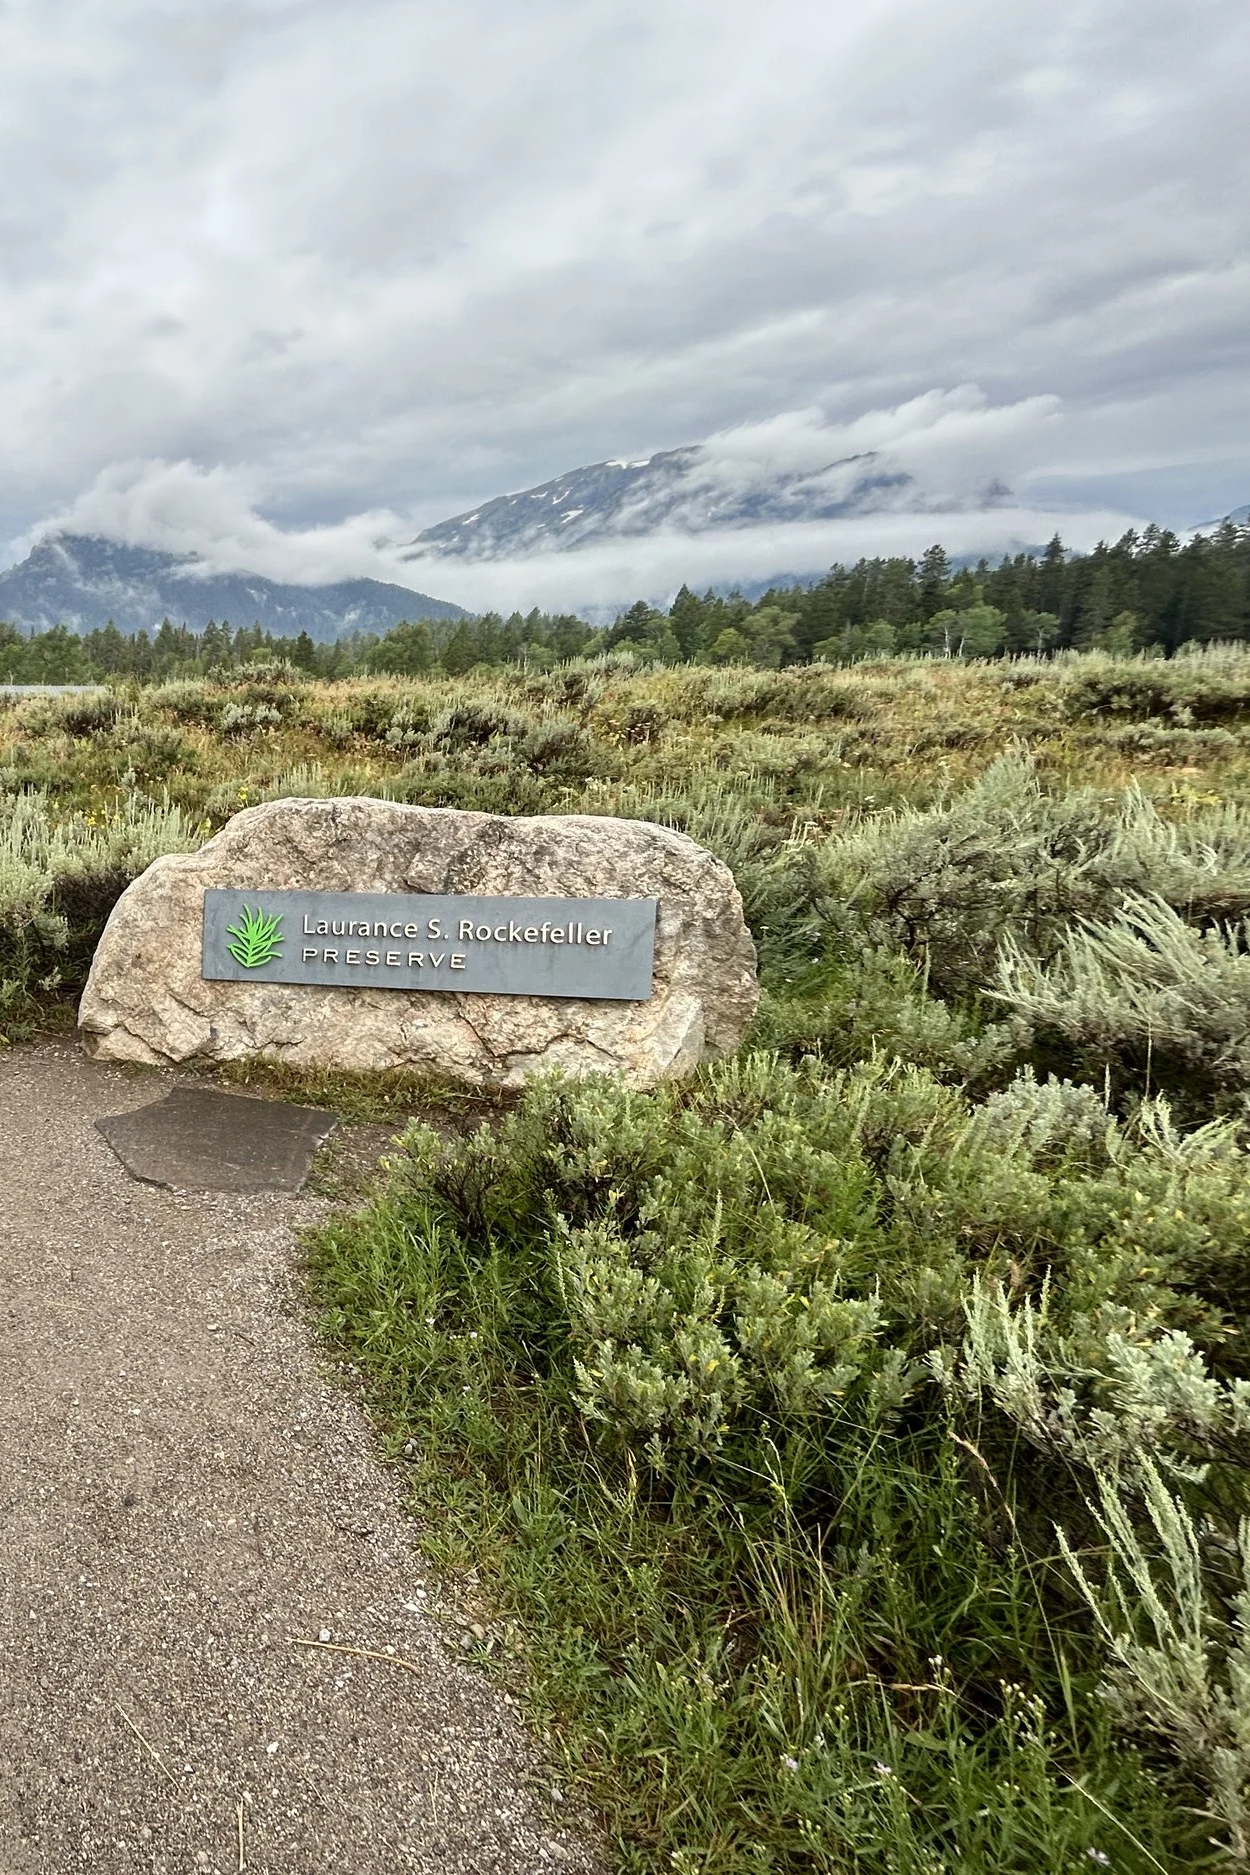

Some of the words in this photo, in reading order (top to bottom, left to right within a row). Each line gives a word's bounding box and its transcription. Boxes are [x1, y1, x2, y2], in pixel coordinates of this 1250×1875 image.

[303, 914, 418, 939] Laurance
[427, 918, 449, 940] S.
[459, 919, 613, 946] Rockefeller
[302, 947, 466, 969] PRESERVE
